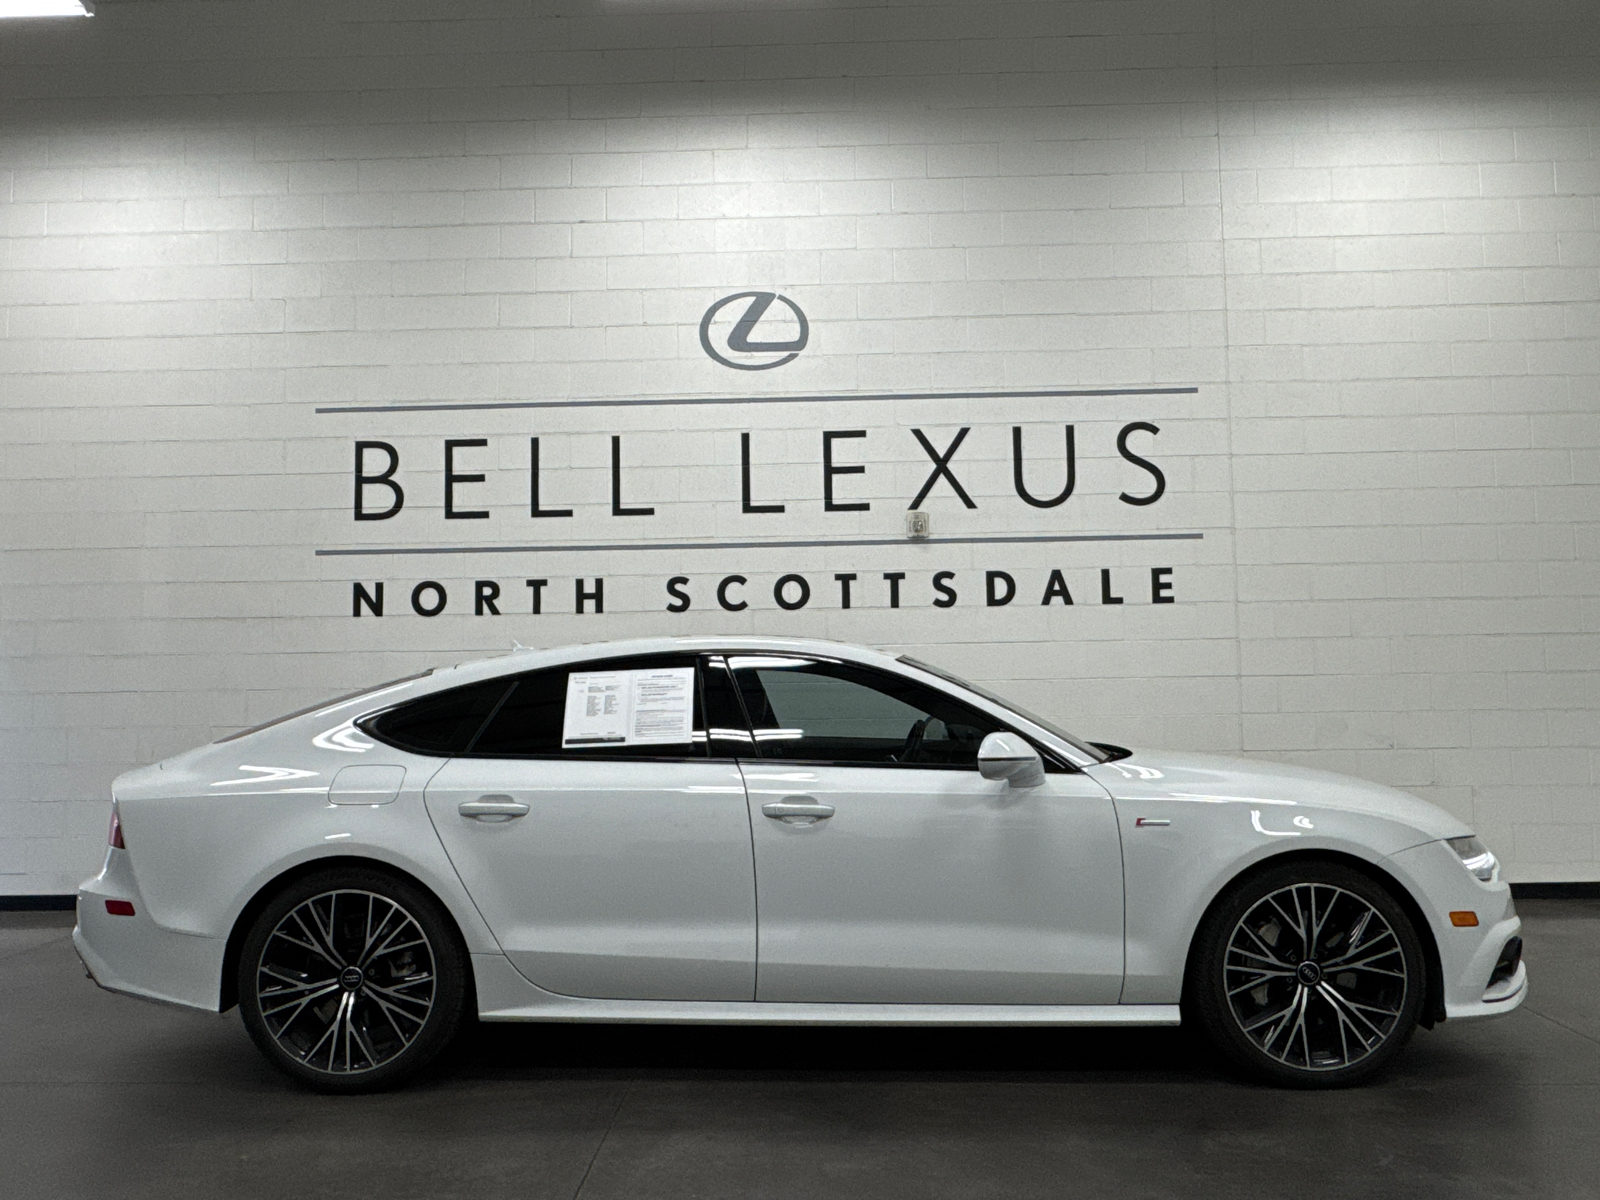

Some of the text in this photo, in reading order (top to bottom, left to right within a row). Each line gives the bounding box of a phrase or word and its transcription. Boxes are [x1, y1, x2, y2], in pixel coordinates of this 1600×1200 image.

[354, 422, 1166, 521] BELL LEXUS
[353, 567, 1176, 617] NORTH SCOTTSDALE
